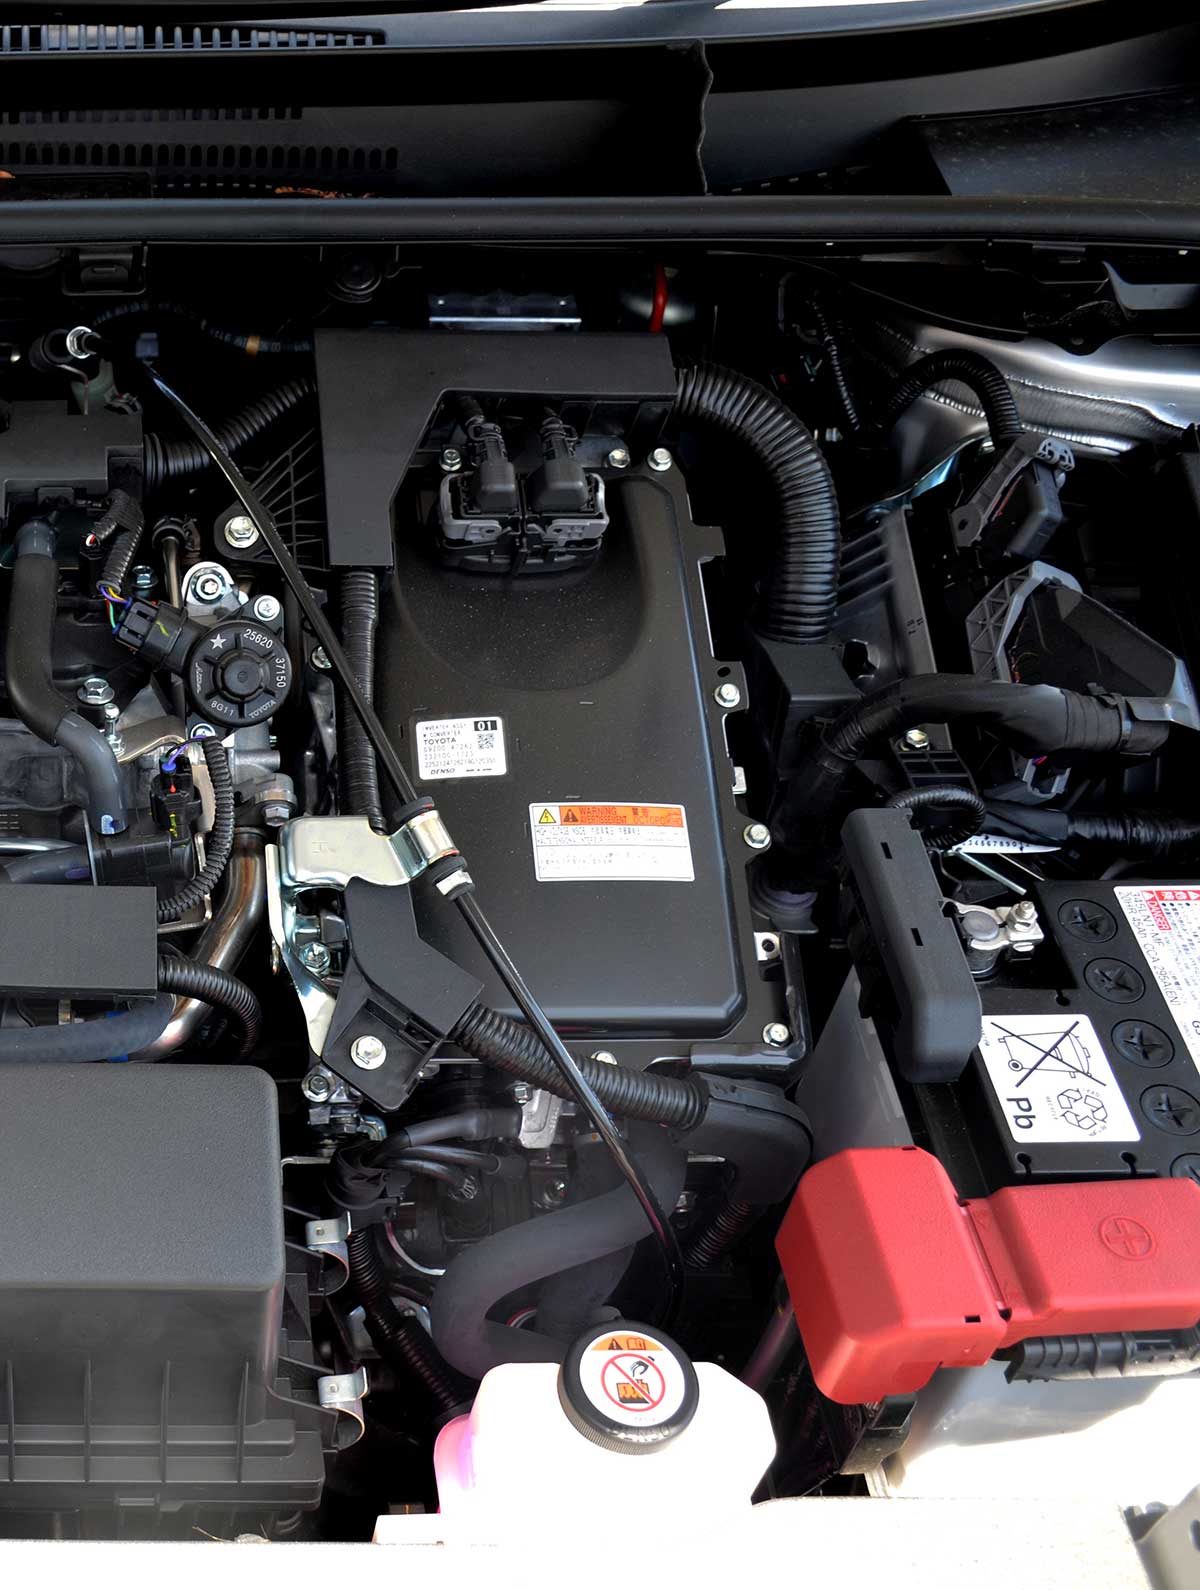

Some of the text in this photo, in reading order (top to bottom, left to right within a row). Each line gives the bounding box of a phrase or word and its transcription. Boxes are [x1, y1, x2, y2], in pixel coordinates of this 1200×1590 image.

[243, 628, 273, 649] 25620
[275, 658, 287, 688] 37150
[249, 700, 277, 718] TOYOTA
[477, 721, 493, 731] 01
[423, 737, 457, 745] TOYOTA
[579, 807, 617, 815] WARNING
[1148, 900, 1170, 930] DANGER
[1143, 943, 1160, 963] CCA
[1006, 1097, 1036, 1129] Pb
